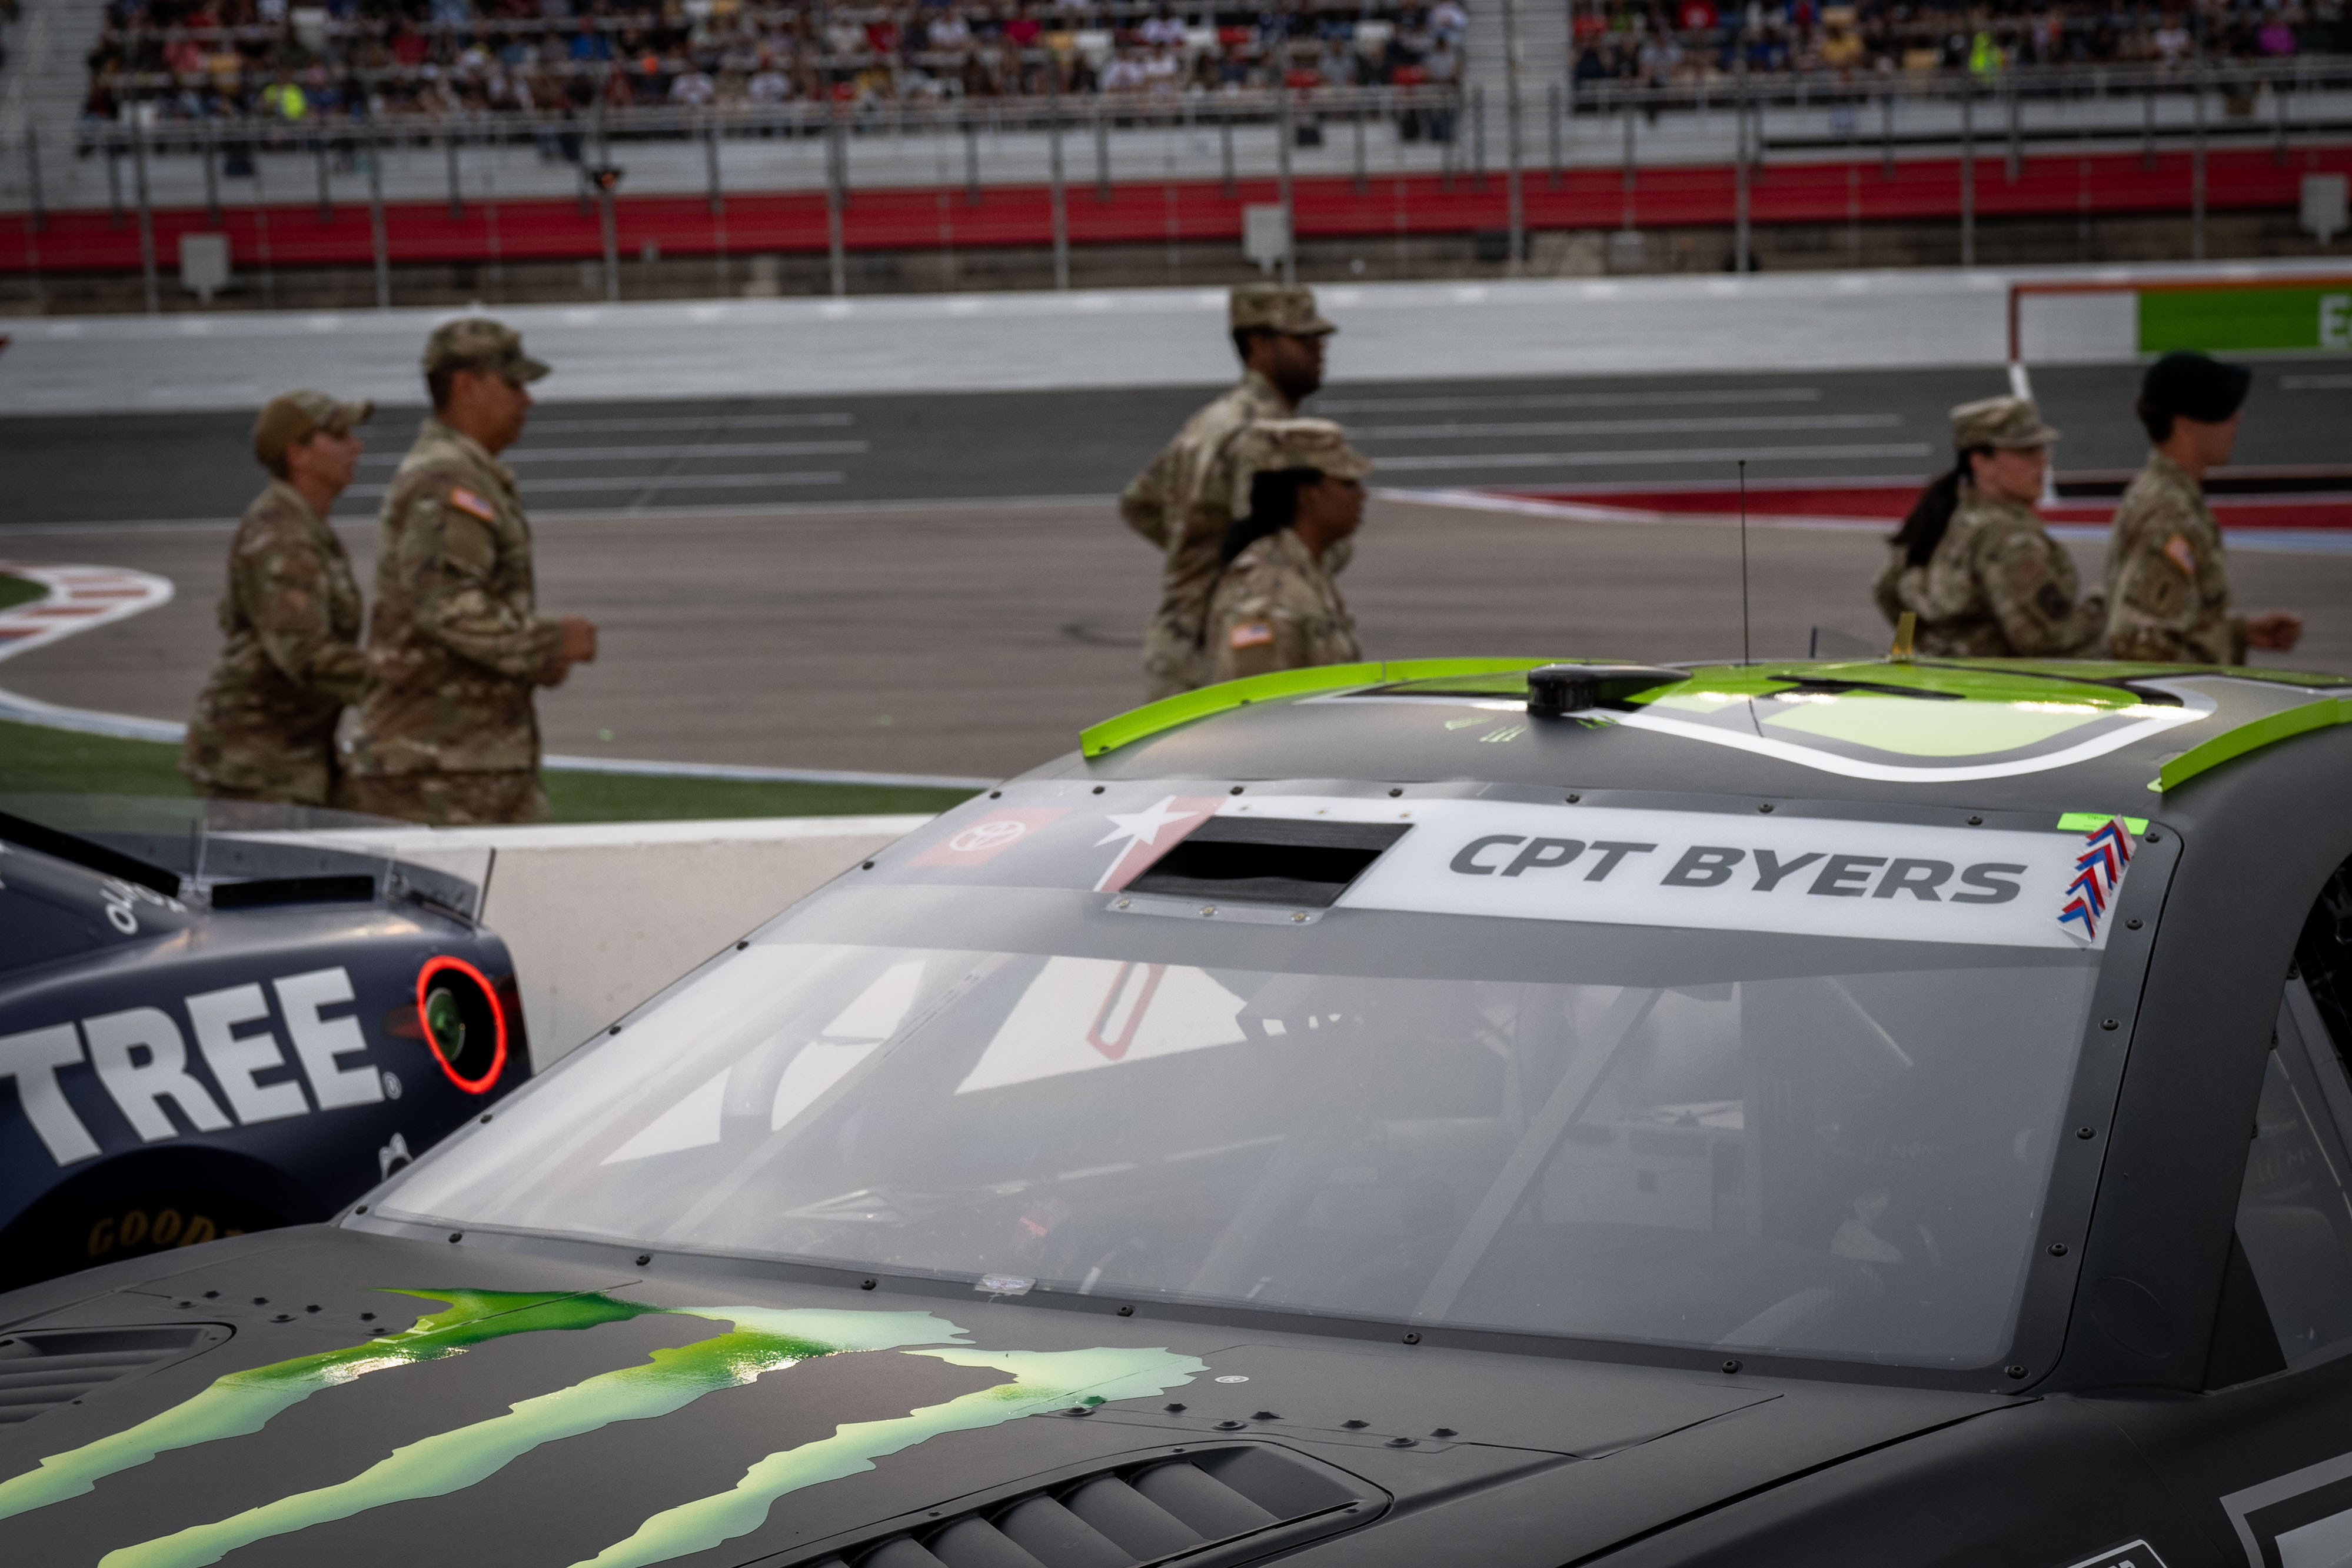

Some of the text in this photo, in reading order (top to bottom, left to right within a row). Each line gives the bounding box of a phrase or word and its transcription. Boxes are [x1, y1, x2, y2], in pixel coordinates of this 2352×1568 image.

[1449, 834, 2029, 904] CPT BYERS
[86, 1207, 242, 1257] GOOD
